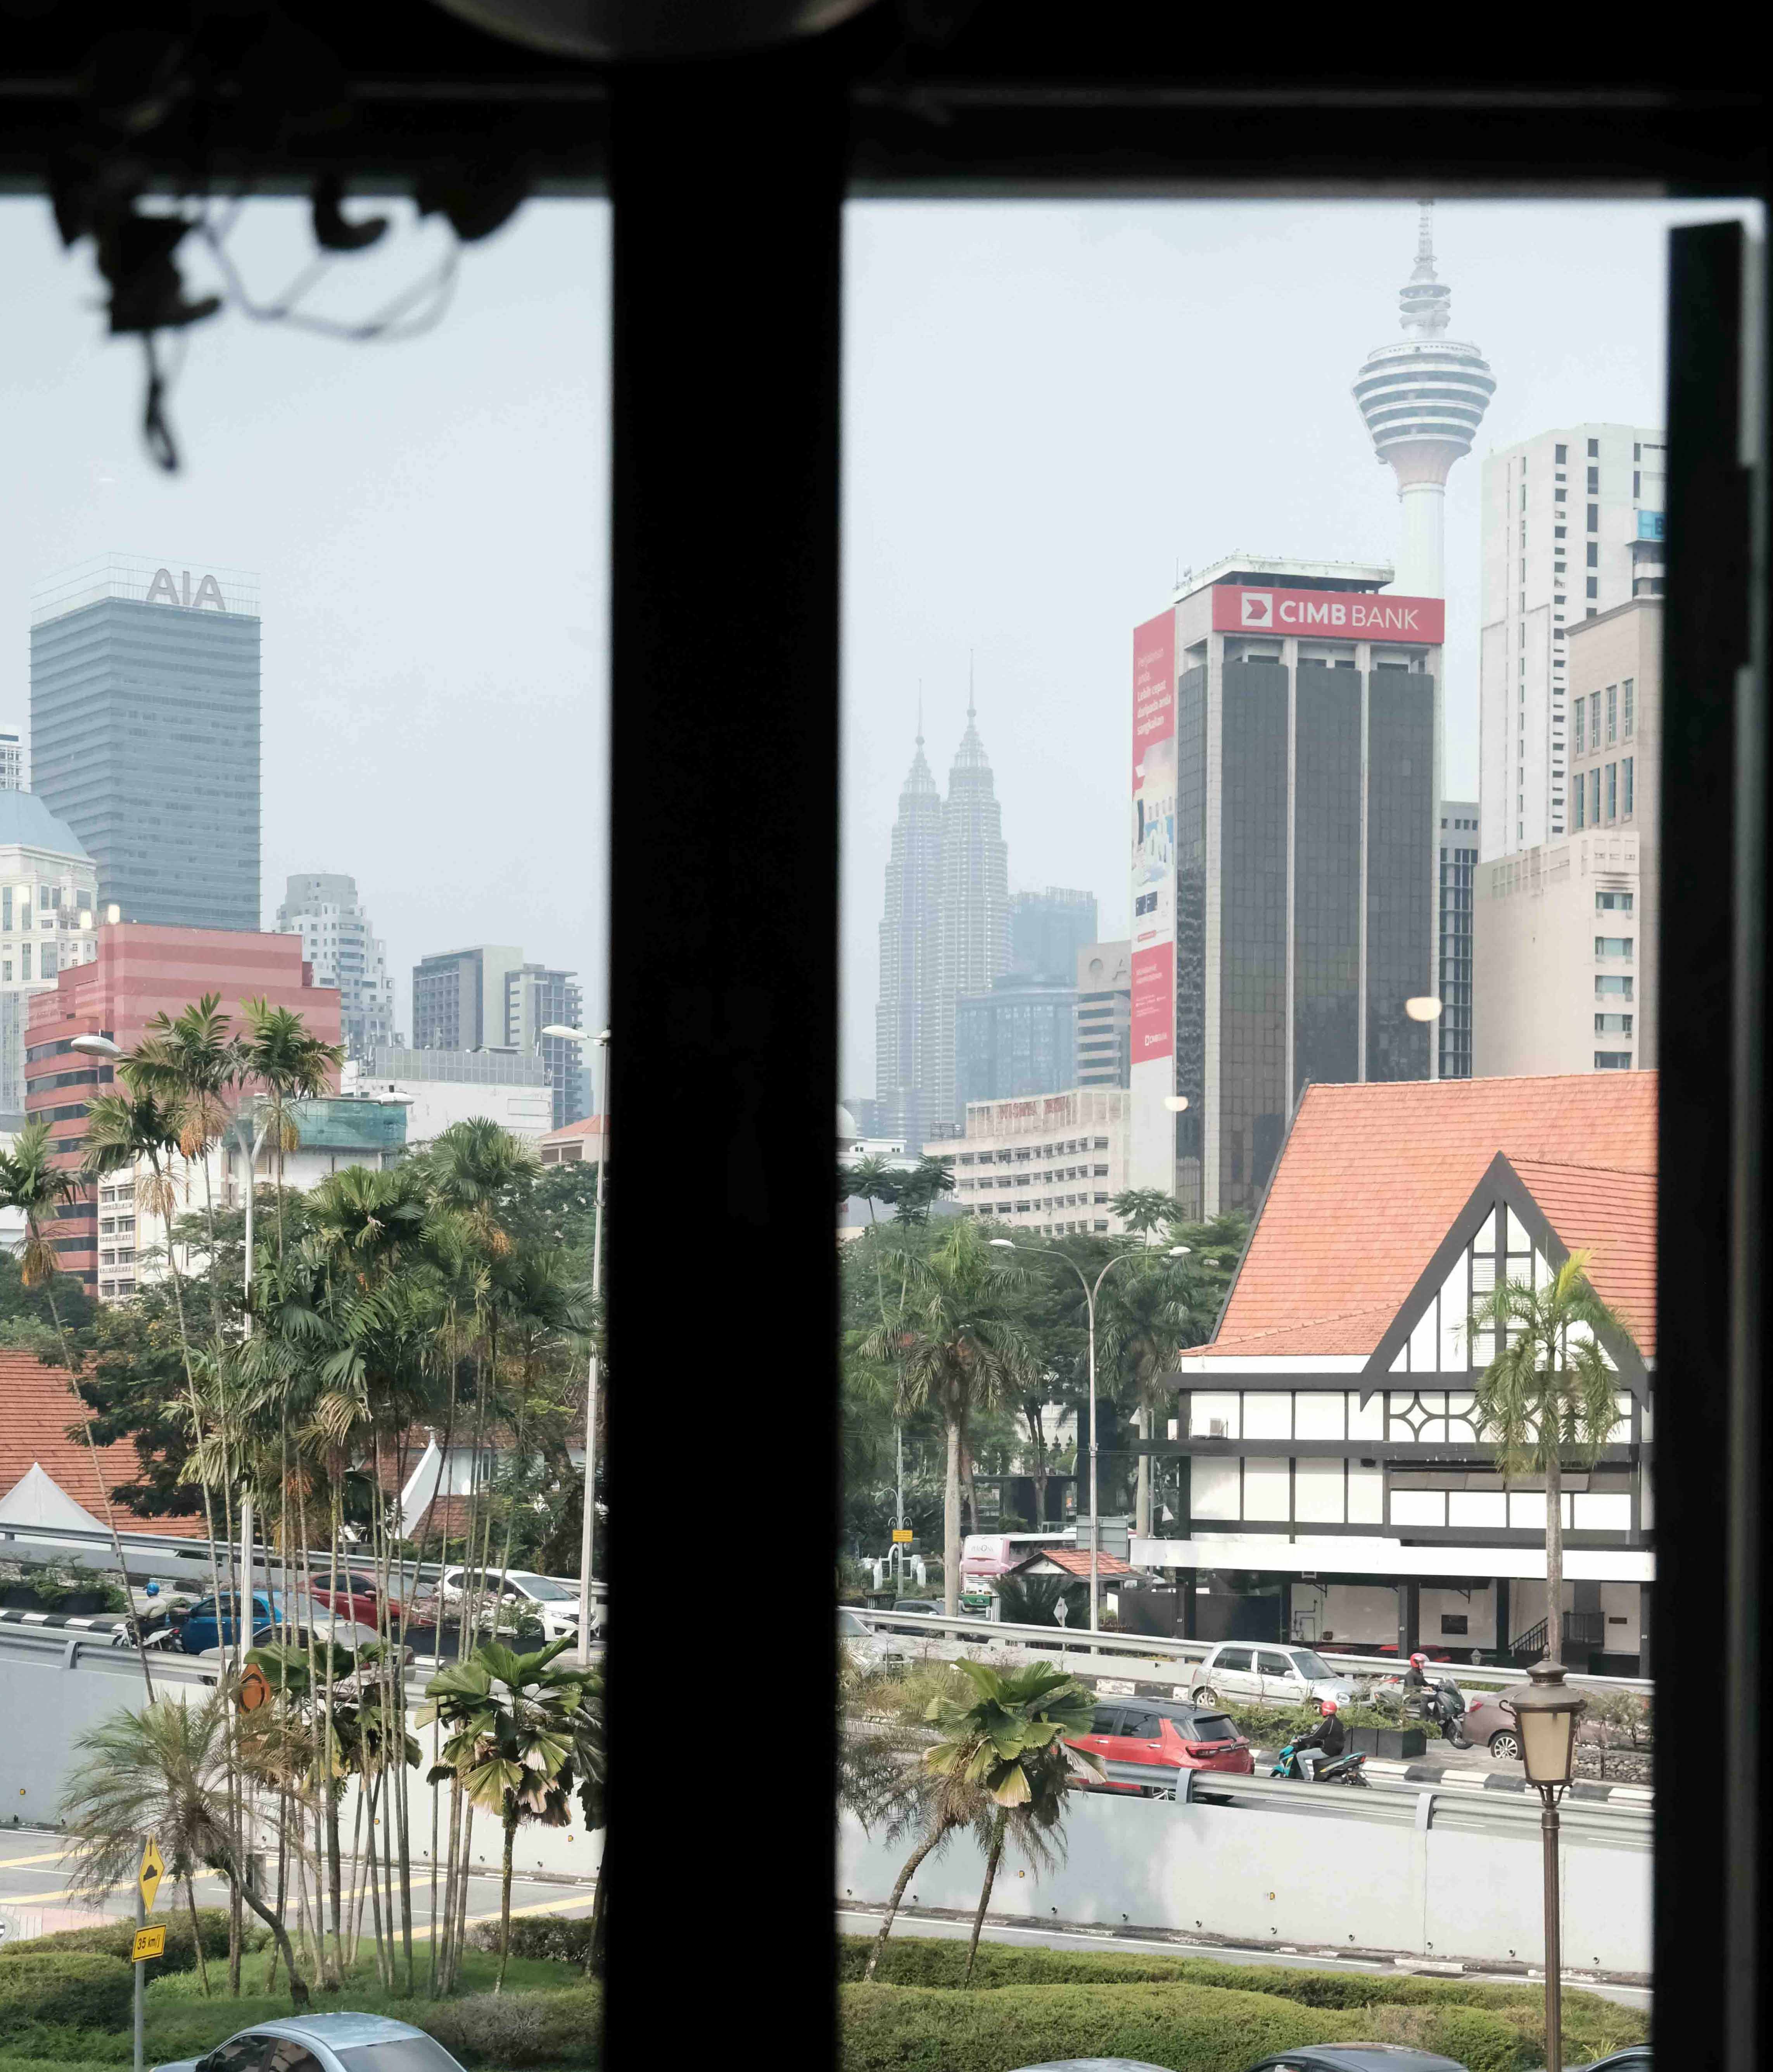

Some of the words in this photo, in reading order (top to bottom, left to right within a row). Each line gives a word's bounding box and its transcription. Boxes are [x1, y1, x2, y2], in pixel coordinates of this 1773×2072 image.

[146, 568, 226, 611] AIA
[1279, 600, 1346, 625] CIMB
[1352, 605, 1419, 630] BANK
[137, 1937, 147, 1950] 35
[147, 1934, 161, 1949] km/j
